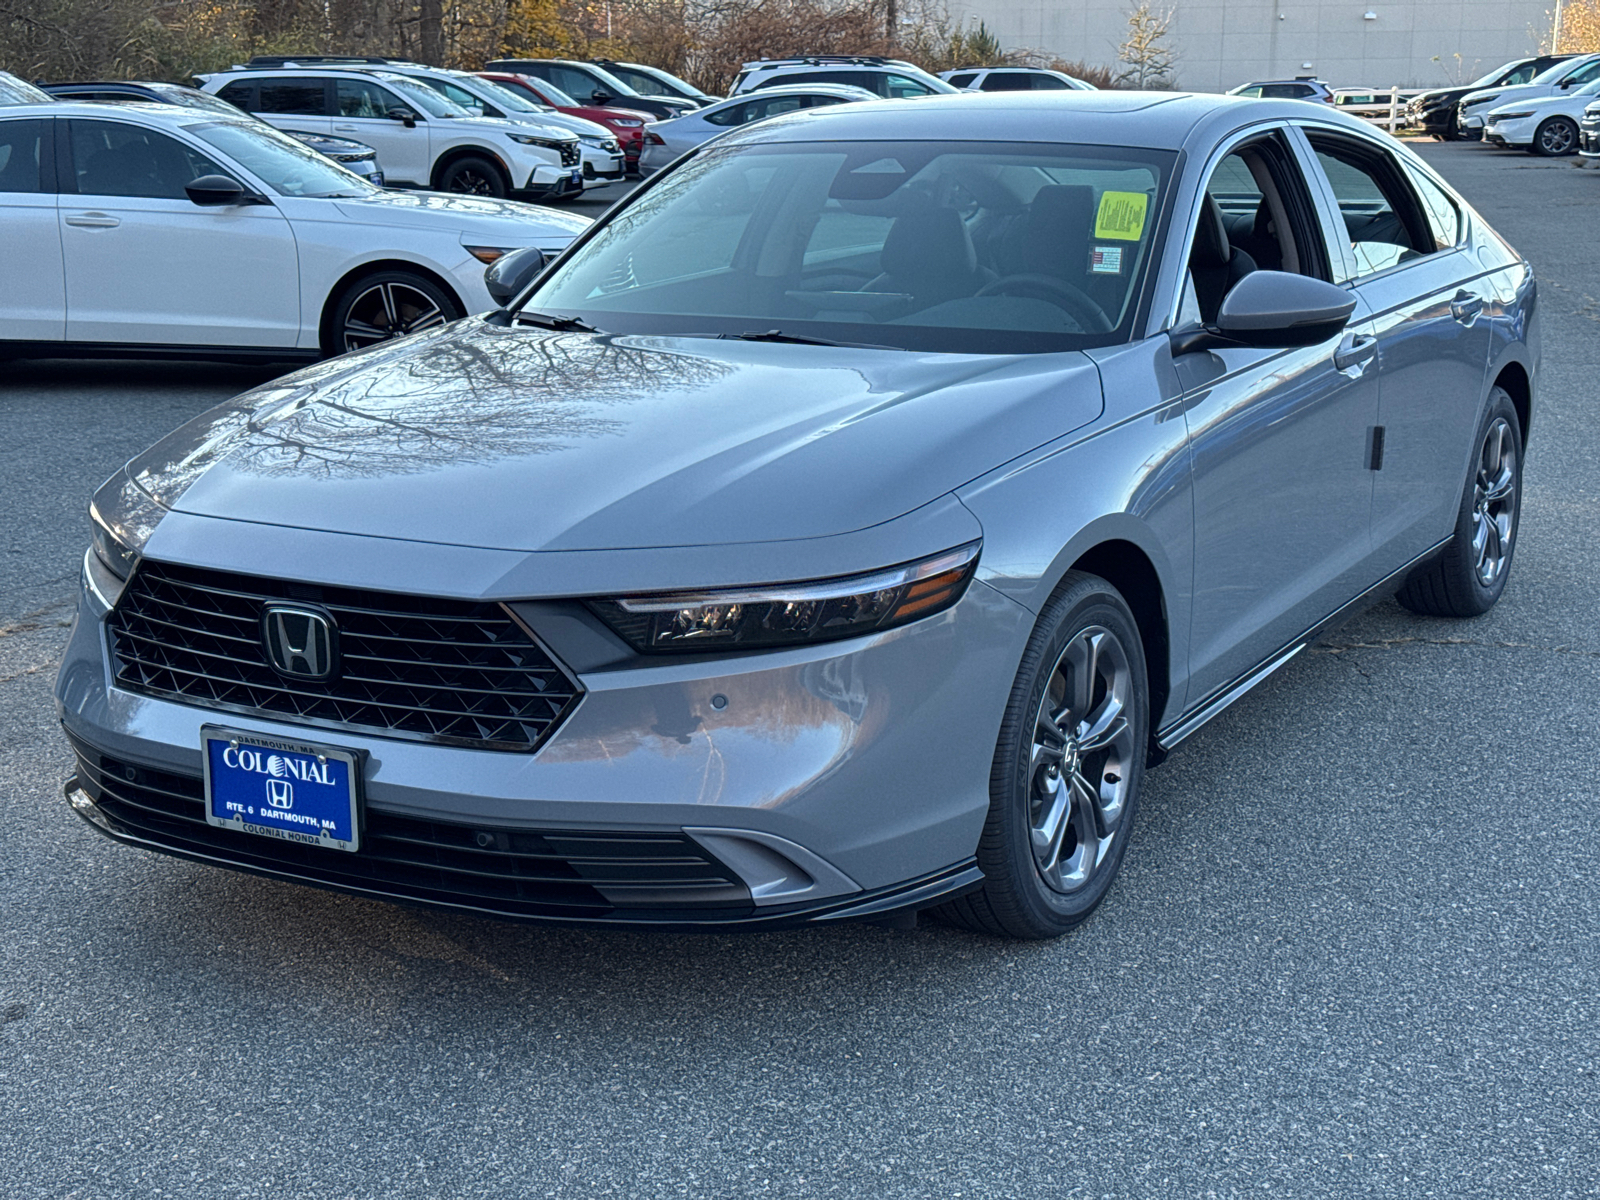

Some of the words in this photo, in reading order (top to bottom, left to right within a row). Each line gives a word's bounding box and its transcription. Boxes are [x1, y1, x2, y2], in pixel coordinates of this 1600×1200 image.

[237, 735, 298, 752] DARTMOUTH,
[301, 746, 315, 754] MA
[223, 747, 336, 786] COLONIAL
[226, 801, 246, 813] RTE.
[248, 806, 254, 814] 6
[260, 808, 320, 828] DARTMOUTH,
[322, 819, 336, 830] MA
[242, 823, 286, 839] COLONIAL
[288, 832, 321, 845] HONDA
